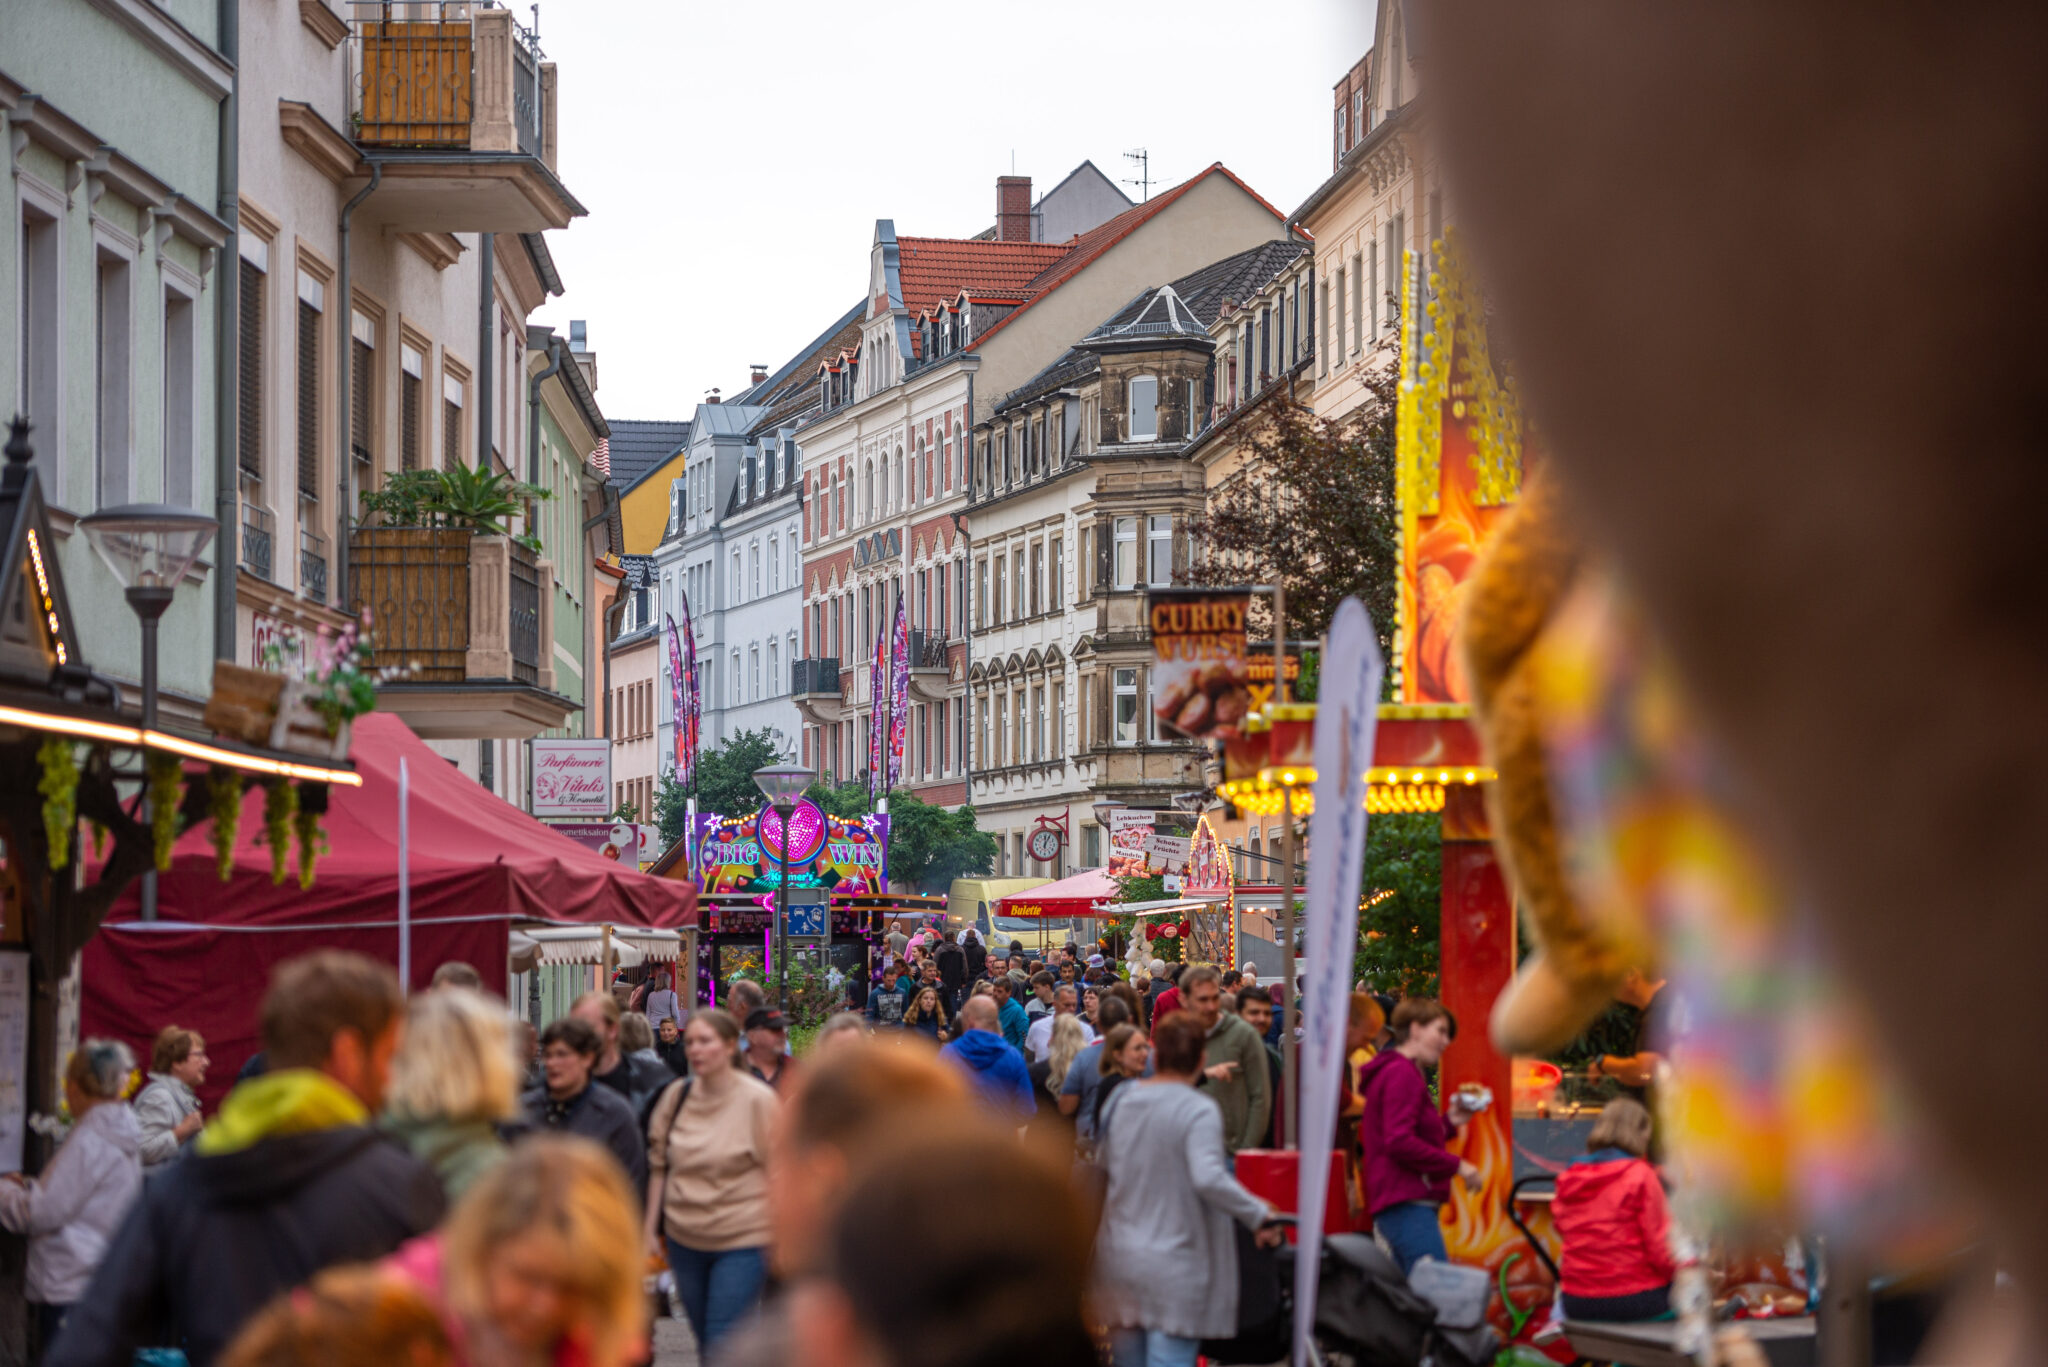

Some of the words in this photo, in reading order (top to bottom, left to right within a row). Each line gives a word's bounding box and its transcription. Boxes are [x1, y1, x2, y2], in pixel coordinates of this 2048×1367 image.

[1151, 602, 1248, 634] CURRY
[1153, 633, 1246, 663] WURST
[537, 752, 605, 772] Parfümerie
[560, 775, 604, 793] Vitalis
[559, 828, 608, 836] osmetiksalon
[1155, 837, 1181, 847] Schoko
[715, 843, 760, 865] BIG
[828, 843, 879, 865] WIN
[1115, 850, 1142, 859] Mandeln
[1153, 844, 1180, 855] Früchte
[768, 871, 814, 881] Krmer's
[1010, 904, 1042, 916] Bulette
